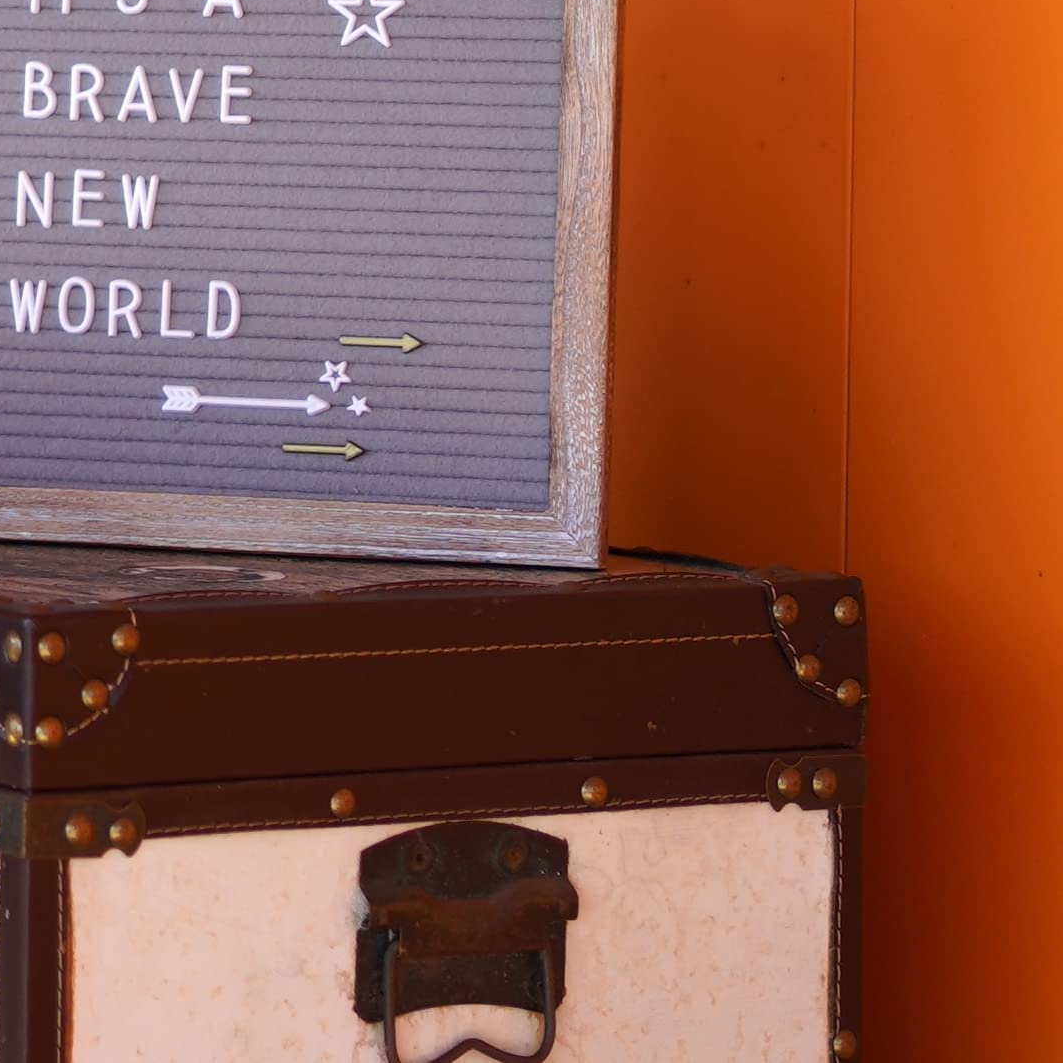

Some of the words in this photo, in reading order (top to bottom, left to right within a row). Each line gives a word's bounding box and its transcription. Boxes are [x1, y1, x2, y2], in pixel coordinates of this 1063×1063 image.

[22, 60, 254, 125] BRAVE
[15, 168, 160, 230] NEW
[9, 275, 241, 340] WORLD
